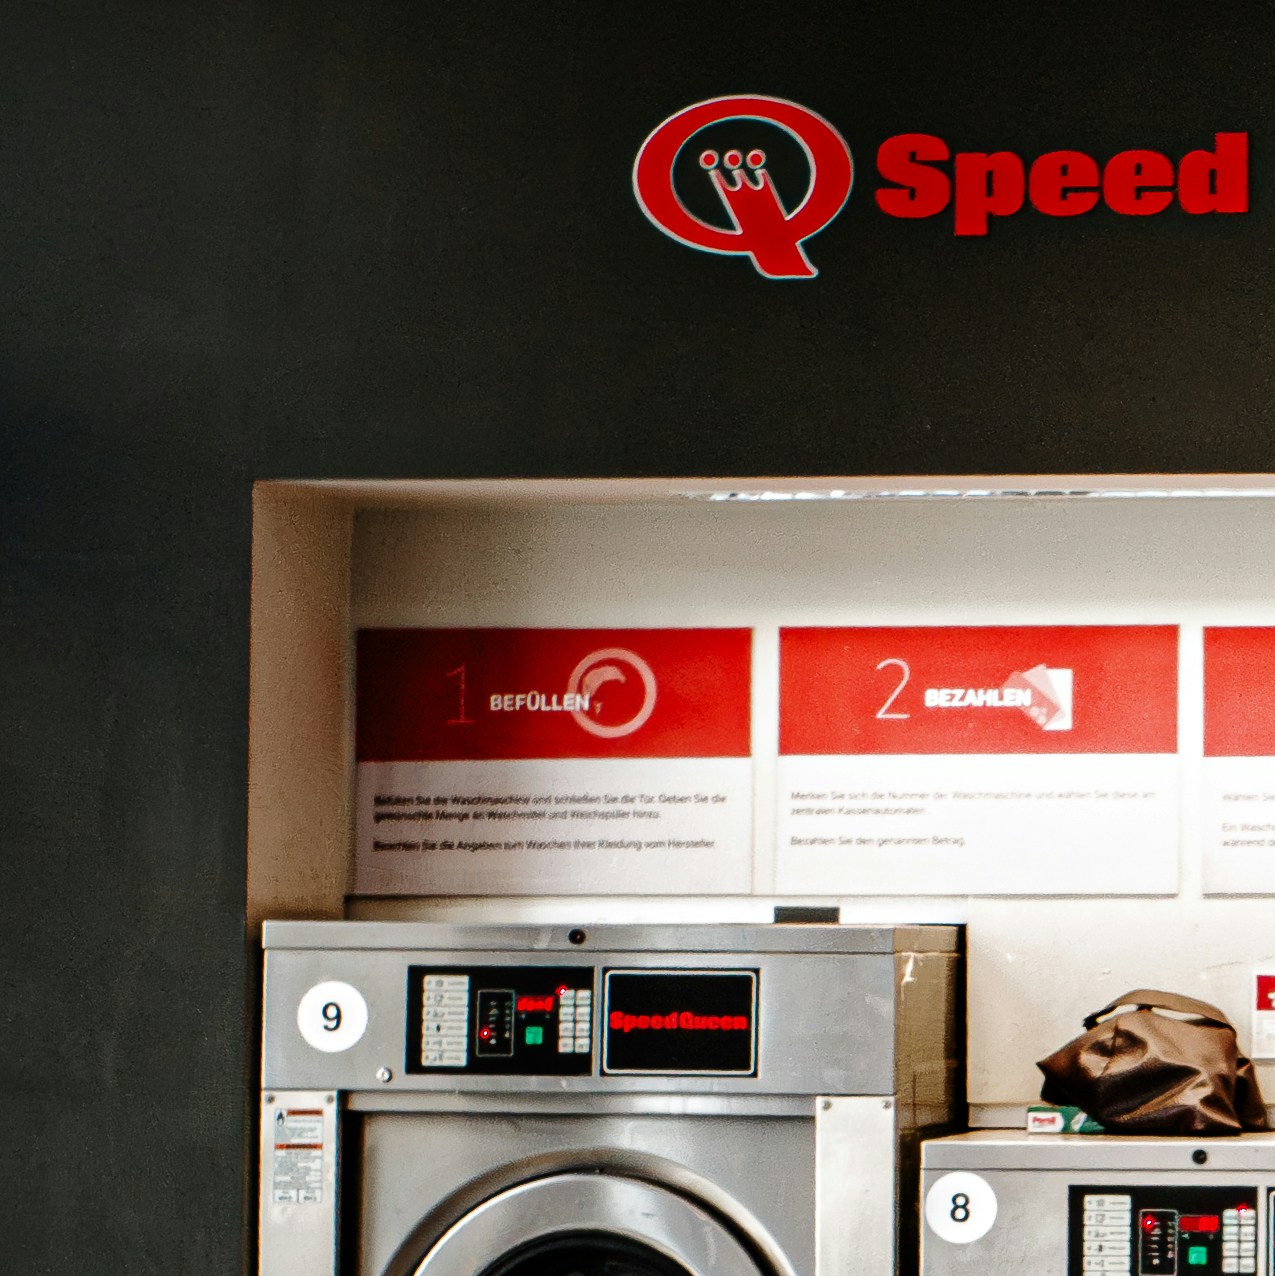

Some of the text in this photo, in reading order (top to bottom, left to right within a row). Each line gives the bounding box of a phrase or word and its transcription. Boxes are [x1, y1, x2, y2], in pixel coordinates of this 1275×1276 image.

[875, 130, 1250, 236] Speed
[446, 662, 590, 725] 1 BEFÜLLEN
[875, 658, 1032, 720] 2 BEZAHLEN
[321, 1002, 341, 1031] 9
[610, 1011, 677, 1033] Speed
[950, 1192, 970, 1222] 8
